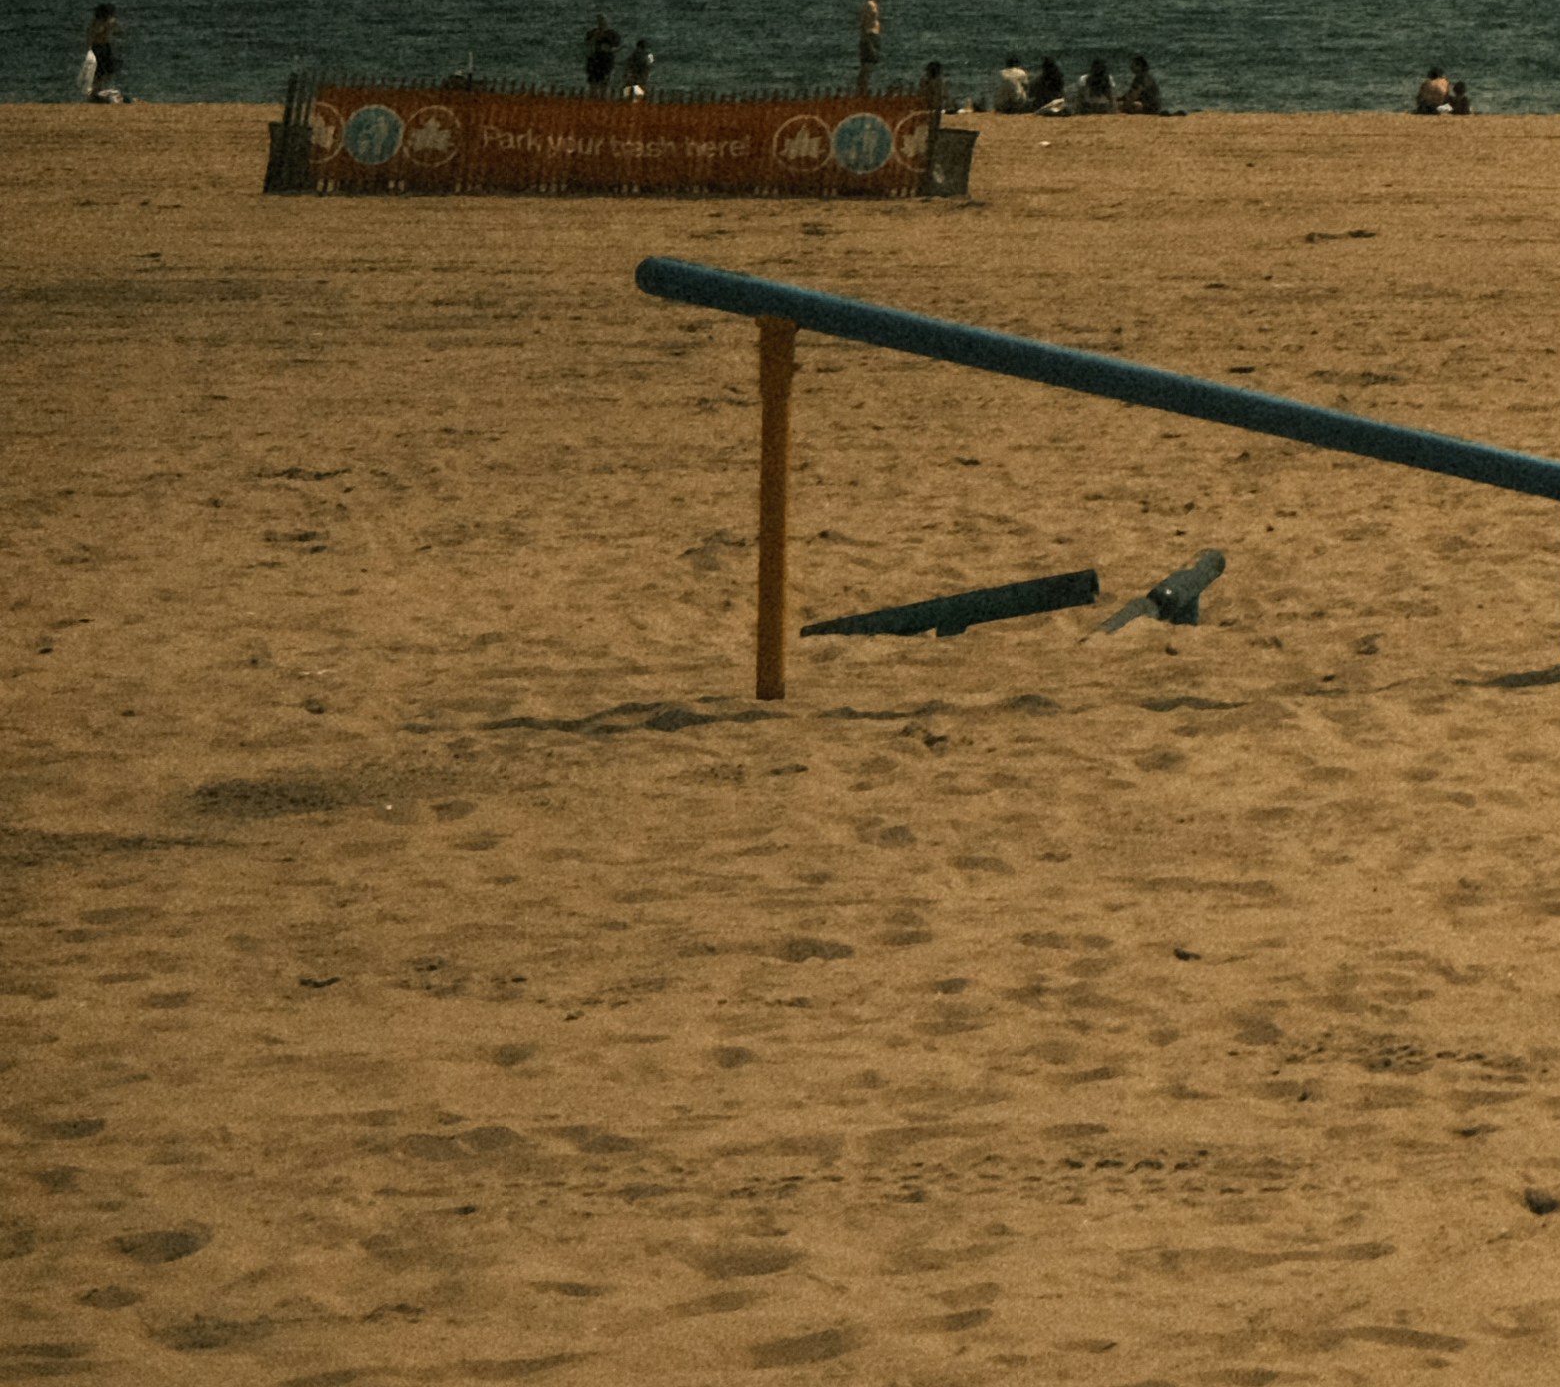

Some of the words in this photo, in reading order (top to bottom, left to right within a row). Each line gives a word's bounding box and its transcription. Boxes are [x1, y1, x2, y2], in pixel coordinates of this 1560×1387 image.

[482, 125, 542, 151] Park
[547, 133, 602, 158] your
[610, 133, 677, 158] trash
